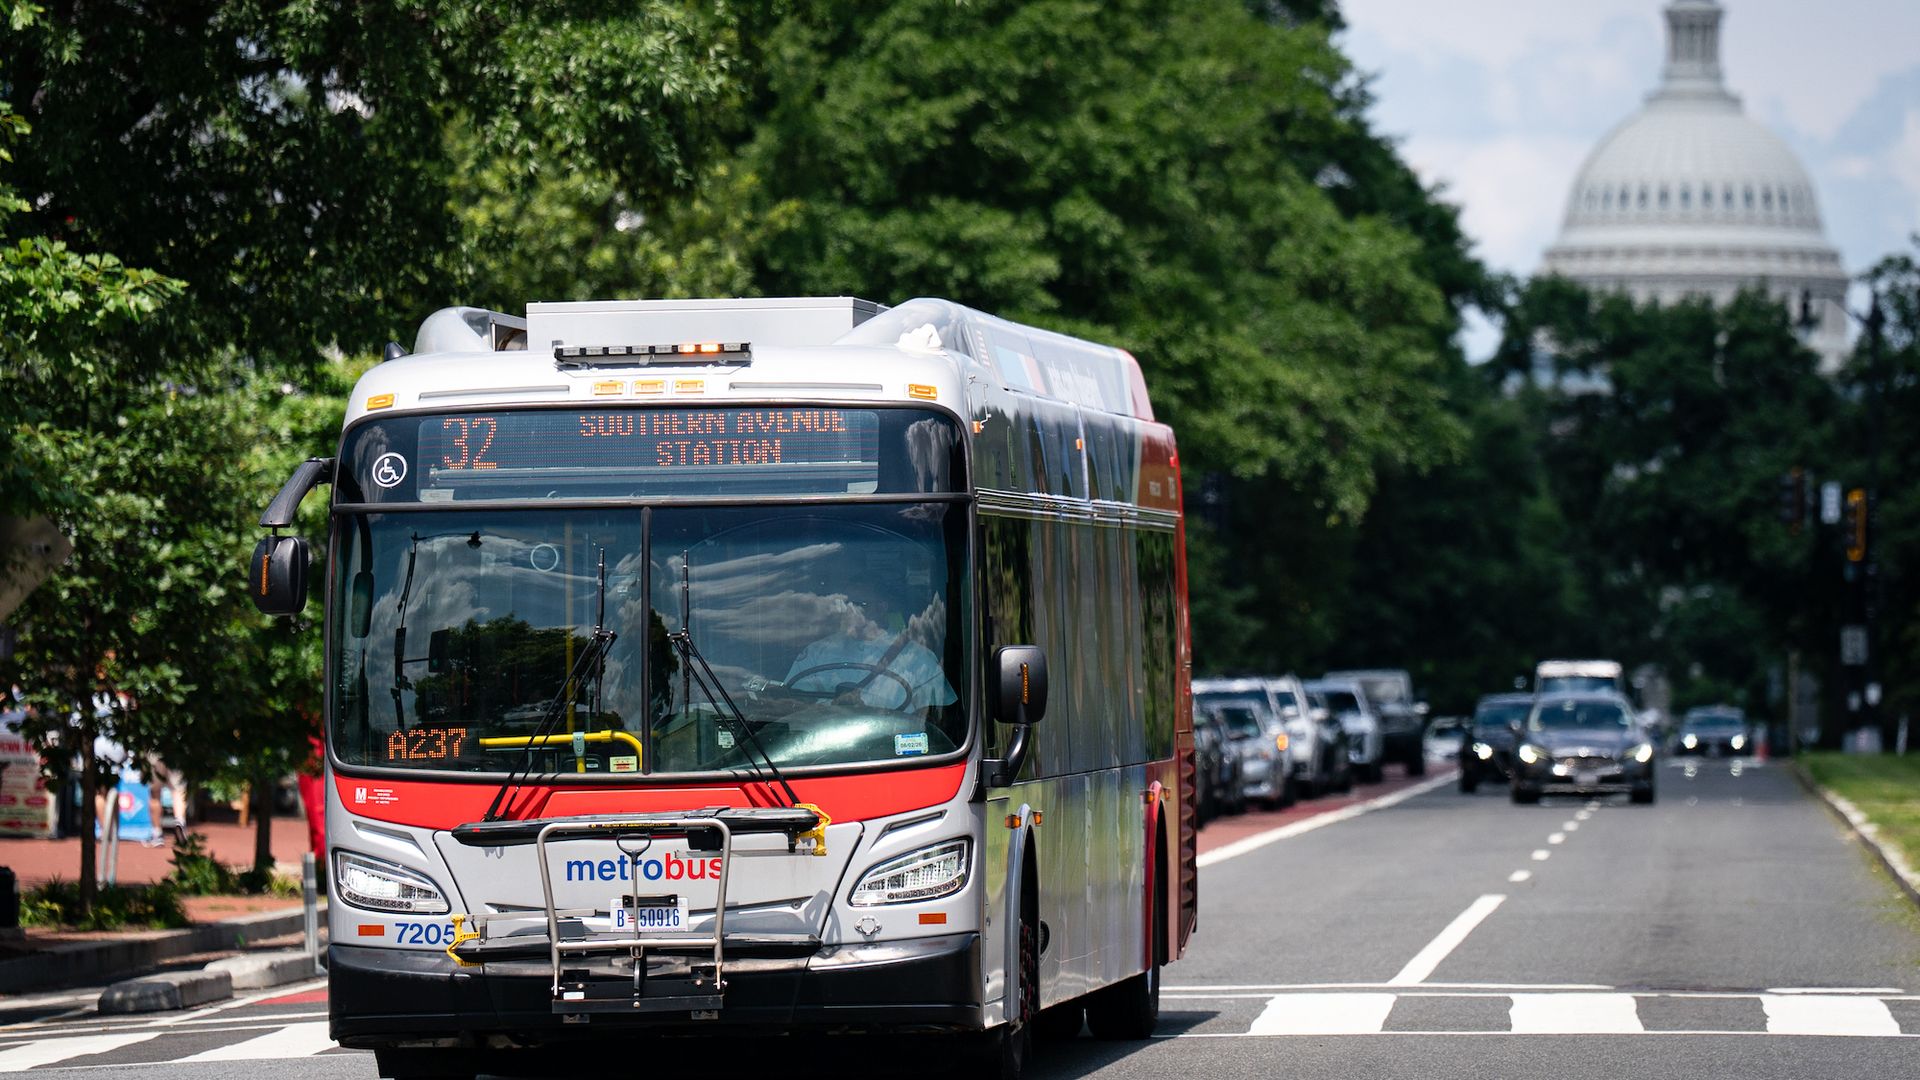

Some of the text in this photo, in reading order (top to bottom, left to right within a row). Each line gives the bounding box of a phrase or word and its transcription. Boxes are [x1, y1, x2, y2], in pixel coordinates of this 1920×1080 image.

[579, 410, 847, 437] SOUTHERN AVENUE
[443, 417, 497, 470] 32
[656, 438, 781, 467] STATION
[388, 727, 467, 761] A237
[566, 852, 724, 882] metrobus
[639, 907, 681, 927] 50916
[394, 922, 456, 946] 7205
